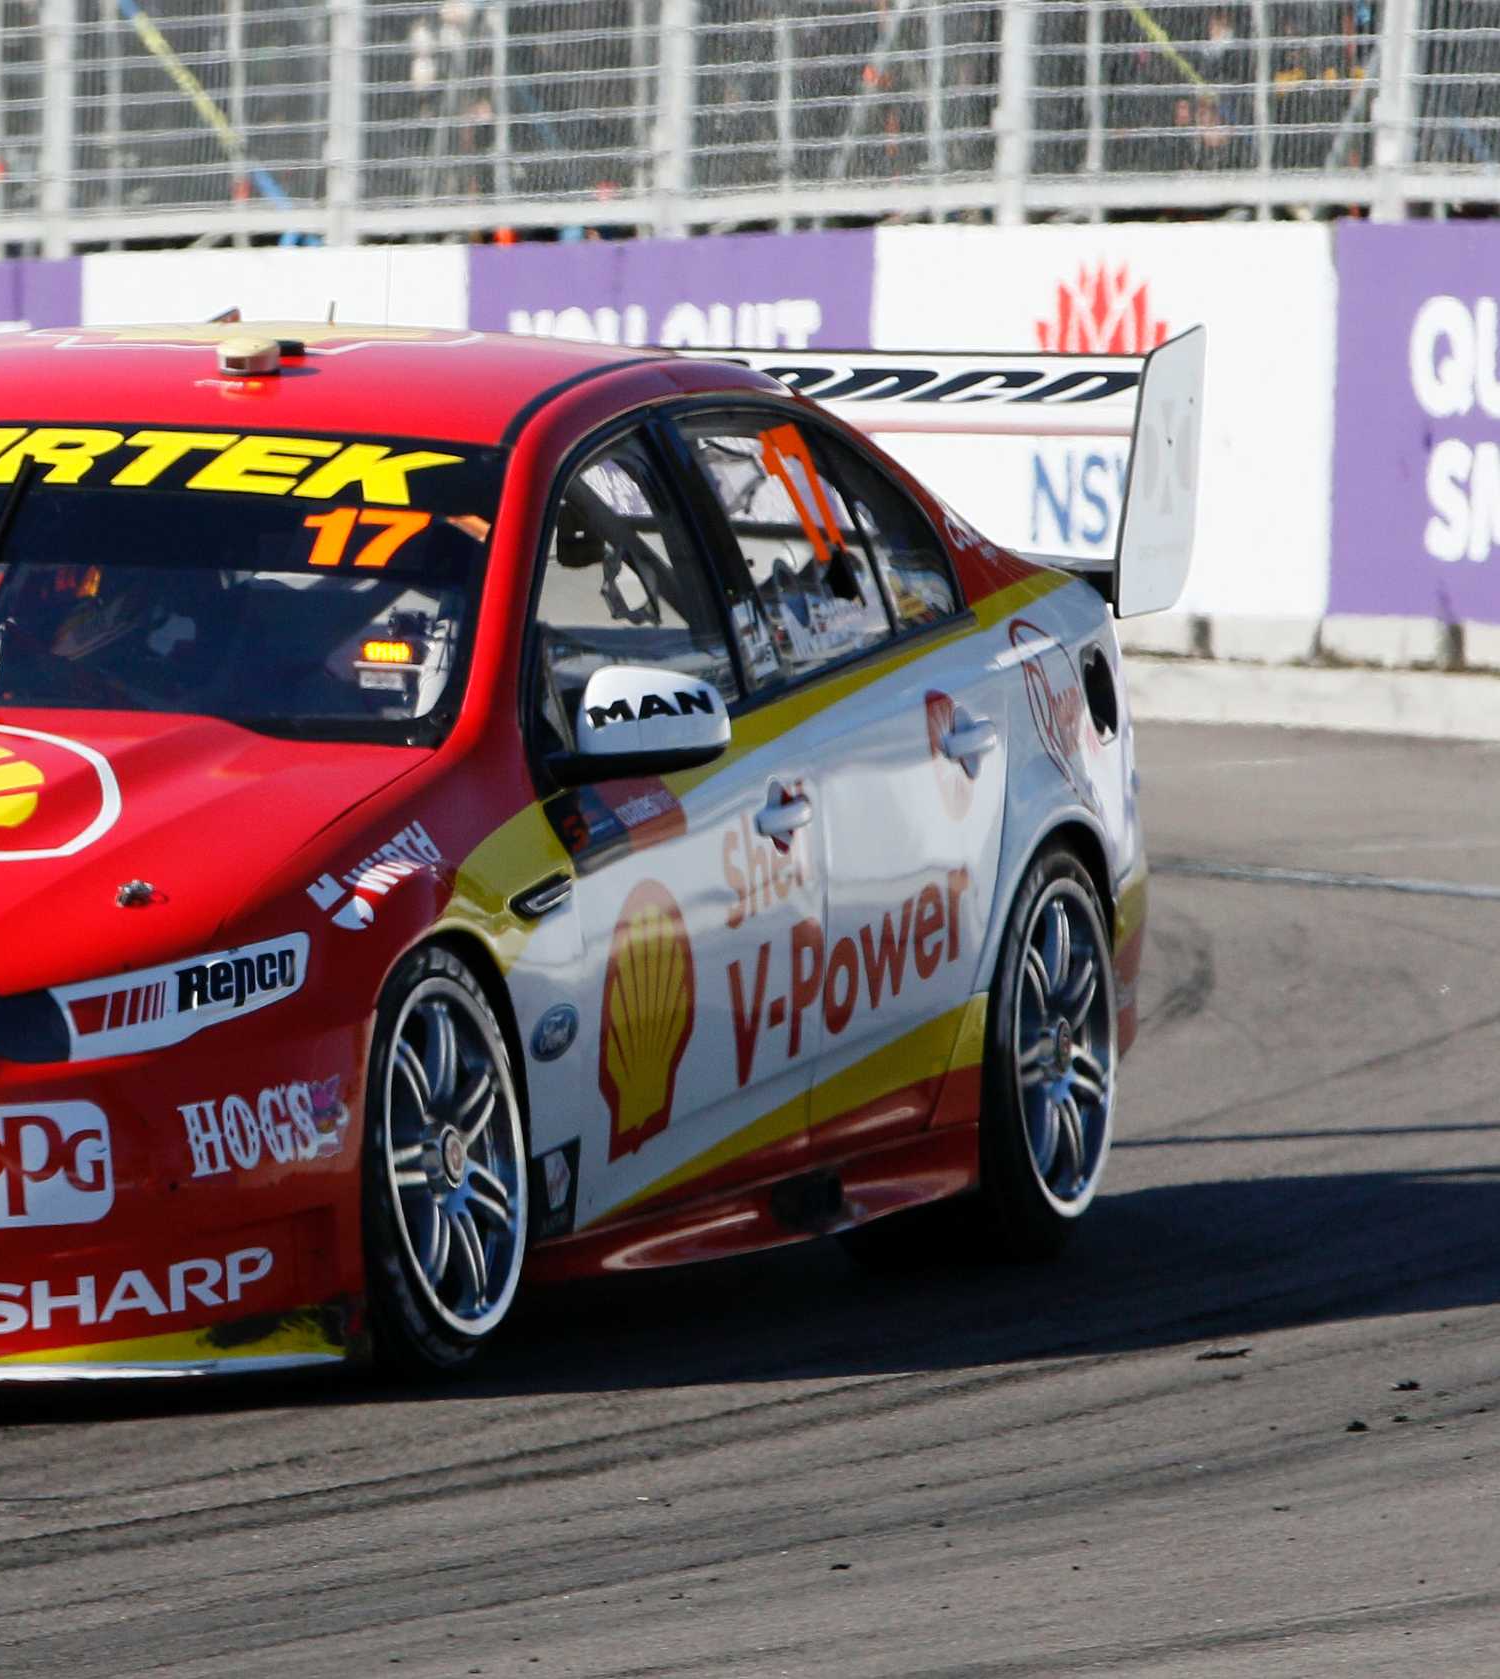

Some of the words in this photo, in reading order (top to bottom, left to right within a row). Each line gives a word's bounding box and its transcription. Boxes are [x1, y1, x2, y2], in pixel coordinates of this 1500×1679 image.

[757, 423, 848, 563] 17
[303, 506, 432, 568] 17
[587, 689, 715, 729] MAN
[175, 949, 296, 1013] Repco
[726, 864, 970, 1088] V-Power
